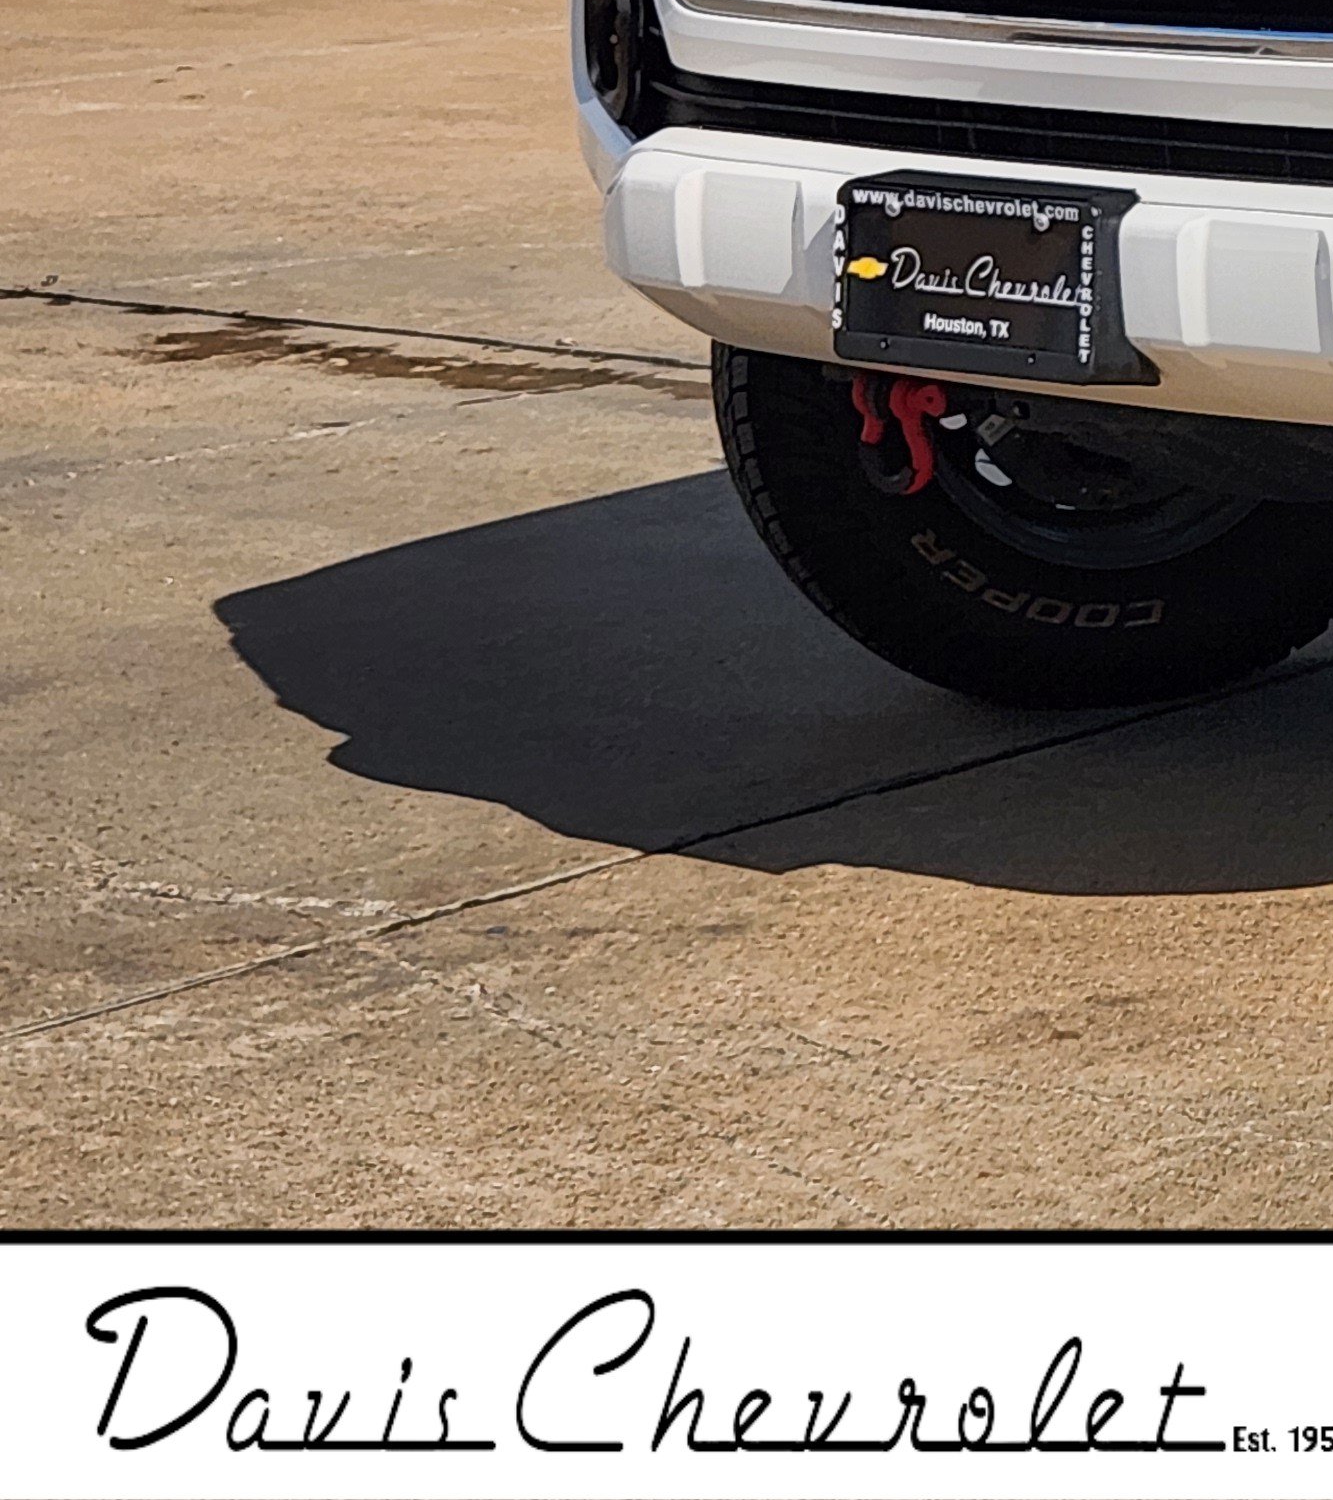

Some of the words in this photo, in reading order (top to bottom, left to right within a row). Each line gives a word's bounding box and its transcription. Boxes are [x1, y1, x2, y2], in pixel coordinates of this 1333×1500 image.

[852, 188, 1080, 223] www.davischevroletcom
[831, 203, 846, 330] DAVIS
[890, 246, 964, 295] Davis
[1078, 225, 1095, 364] CHEVROLET
[923, 312, 987, 339] Houston,
[990, 320, 1011, 339] TX
[910, 527, 1167, 629] COOPER
